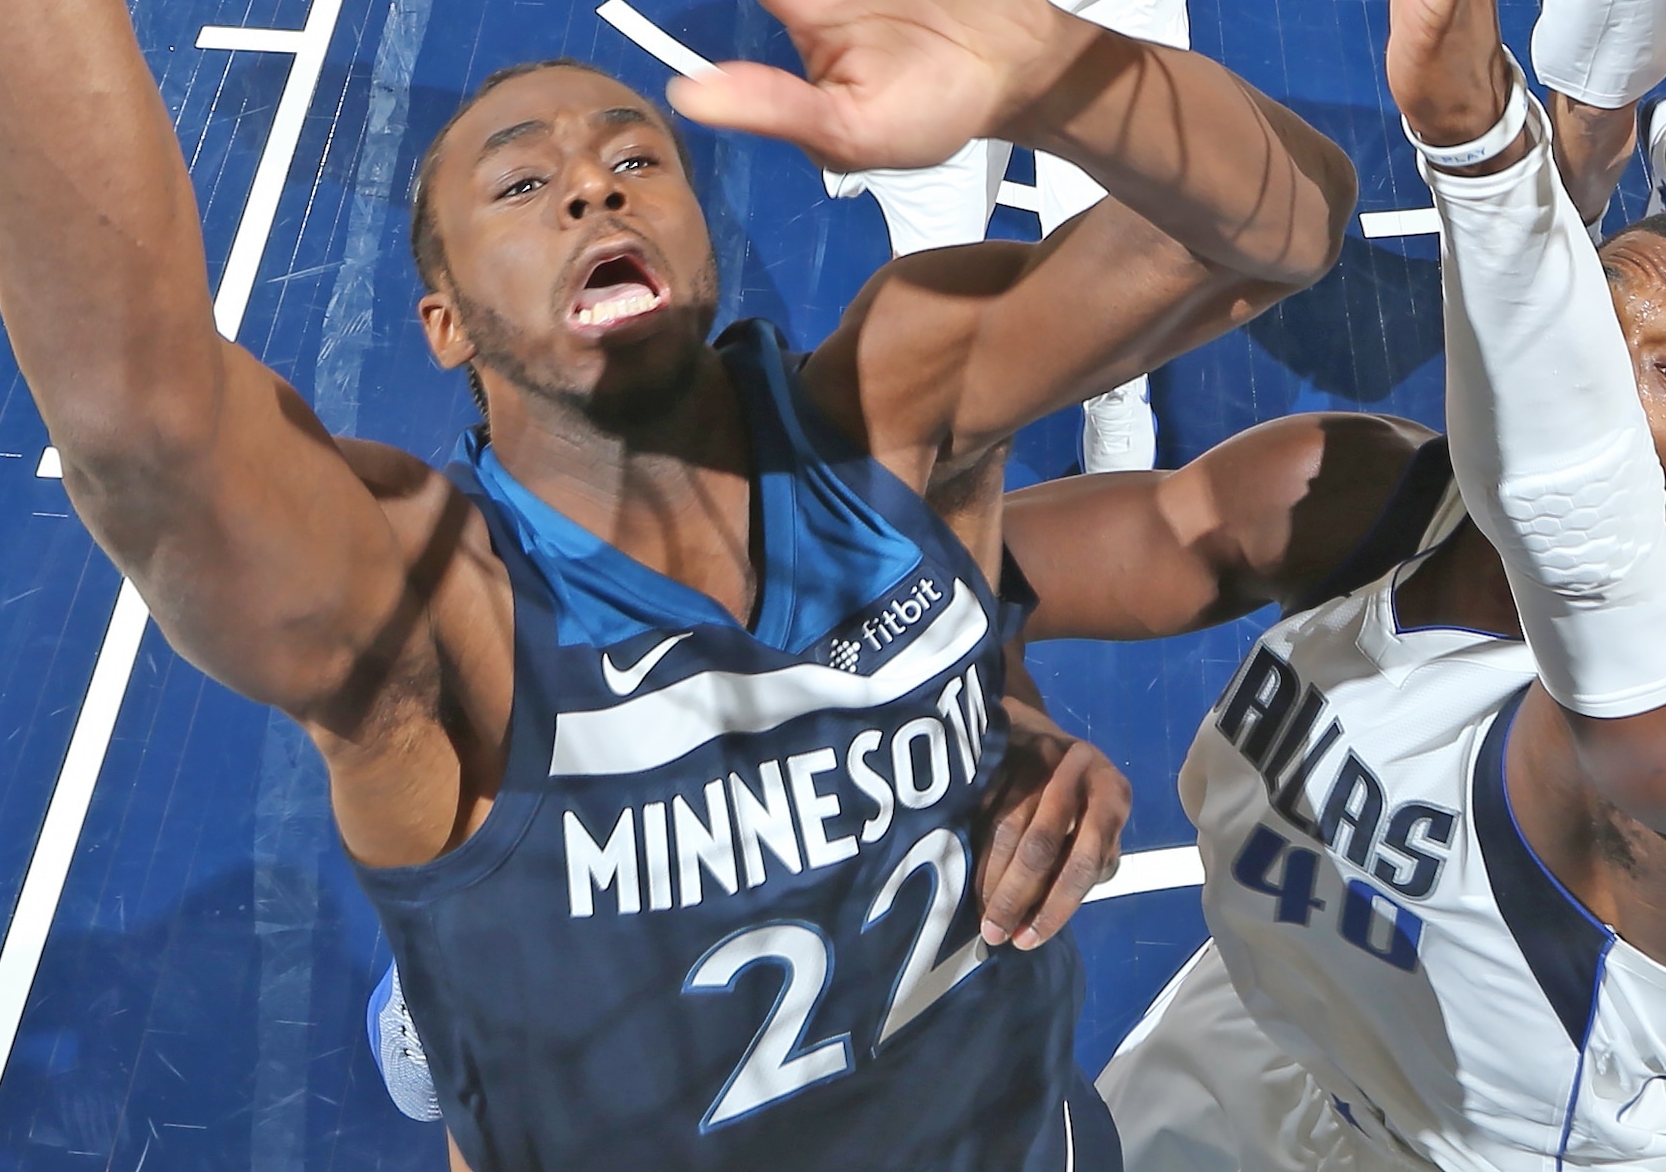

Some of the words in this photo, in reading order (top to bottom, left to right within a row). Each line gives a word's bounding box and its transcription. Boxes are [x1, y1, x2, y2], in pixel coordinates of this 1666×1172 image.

[862, 577, 943, 652] fitbit
[562, 664, 989, 918] MINNESOTA
[1213, 639, 1462, 901] ALLAS
[679, 825, 997, 1136] 22
[1231, 822, 1425, 974] 40
